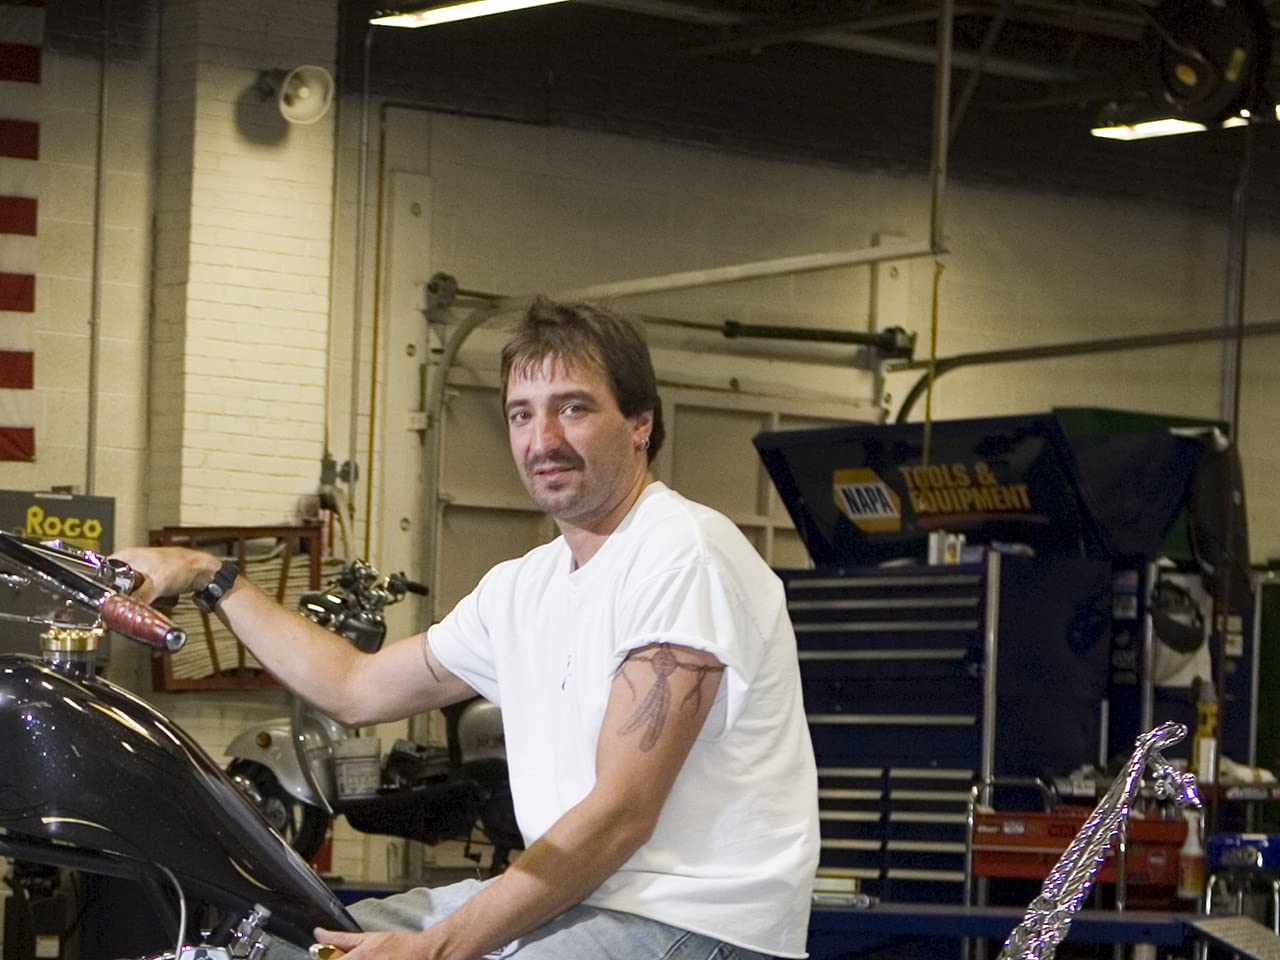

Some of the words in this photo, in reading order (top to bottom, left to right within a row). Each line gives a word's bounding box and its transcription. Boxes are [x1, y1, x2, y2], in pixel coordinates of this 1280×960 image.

[899, 463, 971, 489] TOOLS
[975, 461, 998, 486] &
[841, 485, 896, 515] NAPA
[909, 483, 1033, 512] EQUIPMENT
